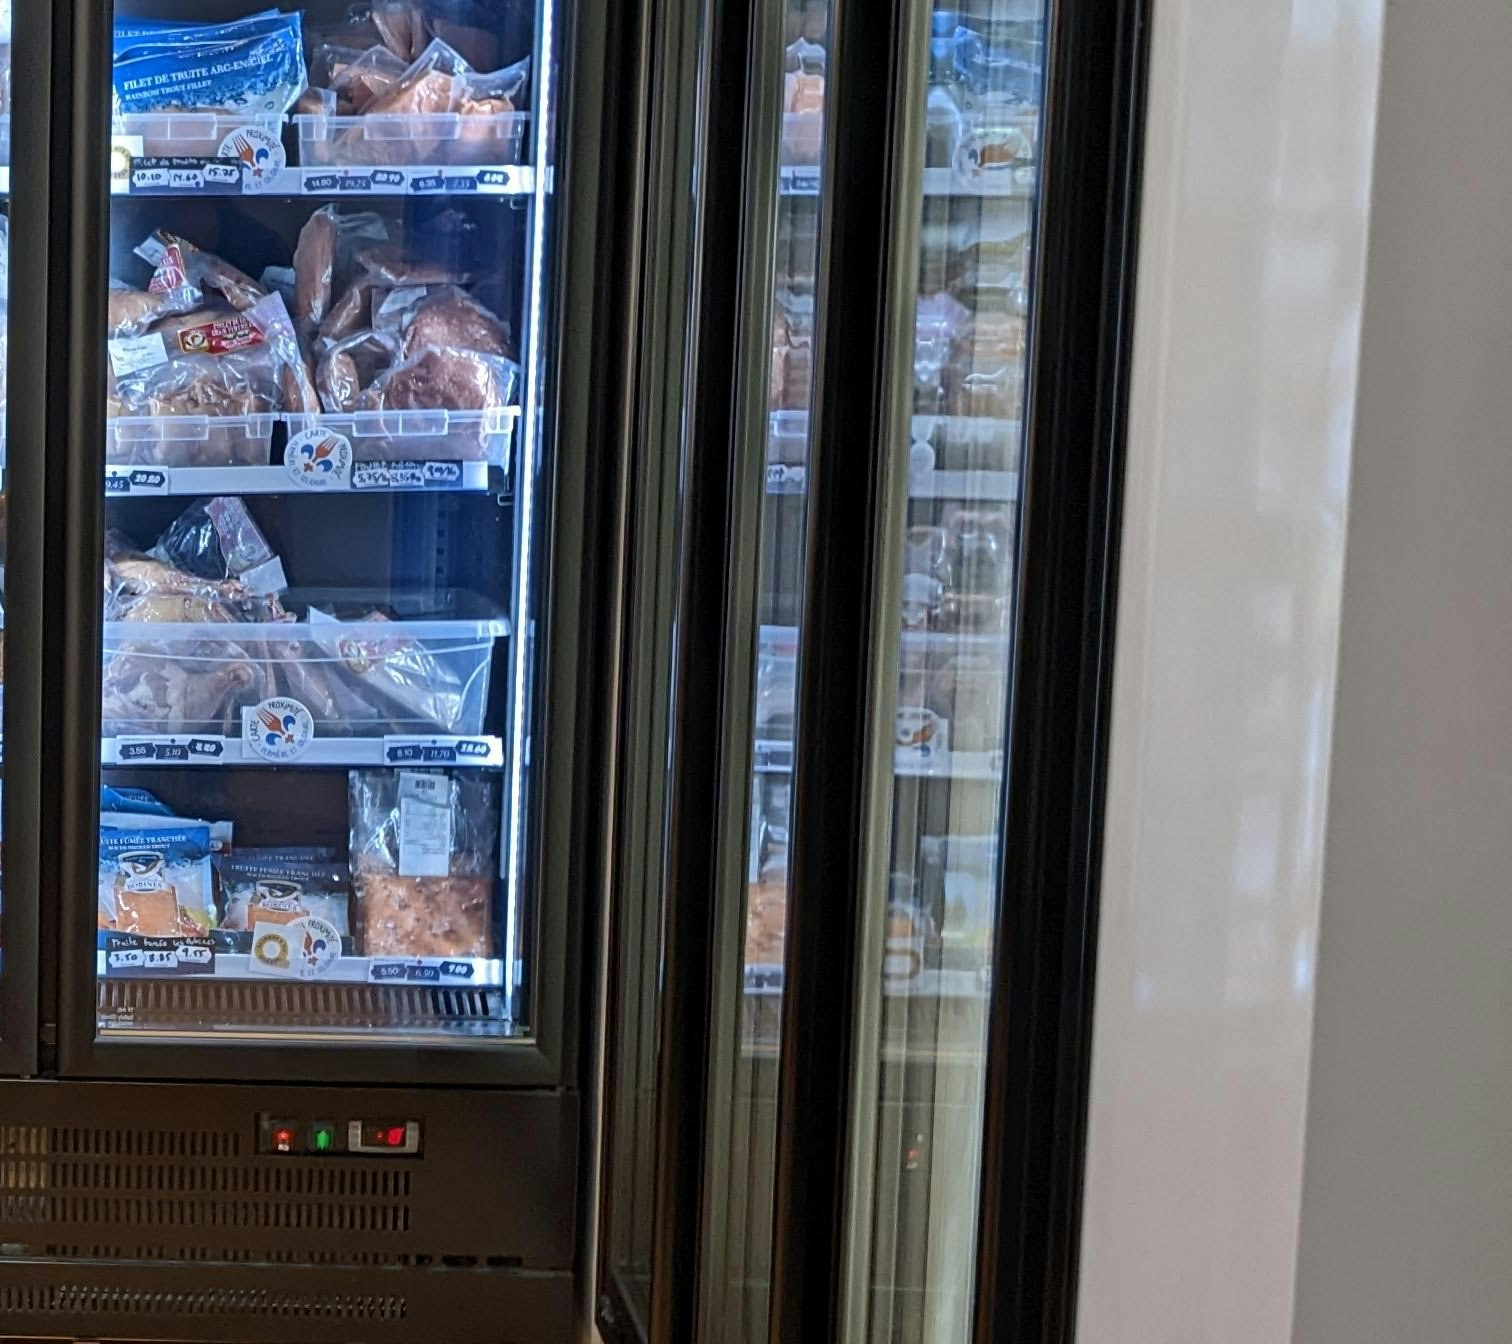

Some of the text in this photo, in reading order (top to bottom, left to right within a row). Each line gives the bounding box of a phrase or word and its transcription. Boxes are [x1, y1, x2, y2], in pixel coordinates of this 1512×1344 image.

[124, 76, 153, 91] FILET
[155, 74, 169, 85] DE
[170, 67, 209, 82] TRUITE
[304, 430, 327, 440] CARTE
